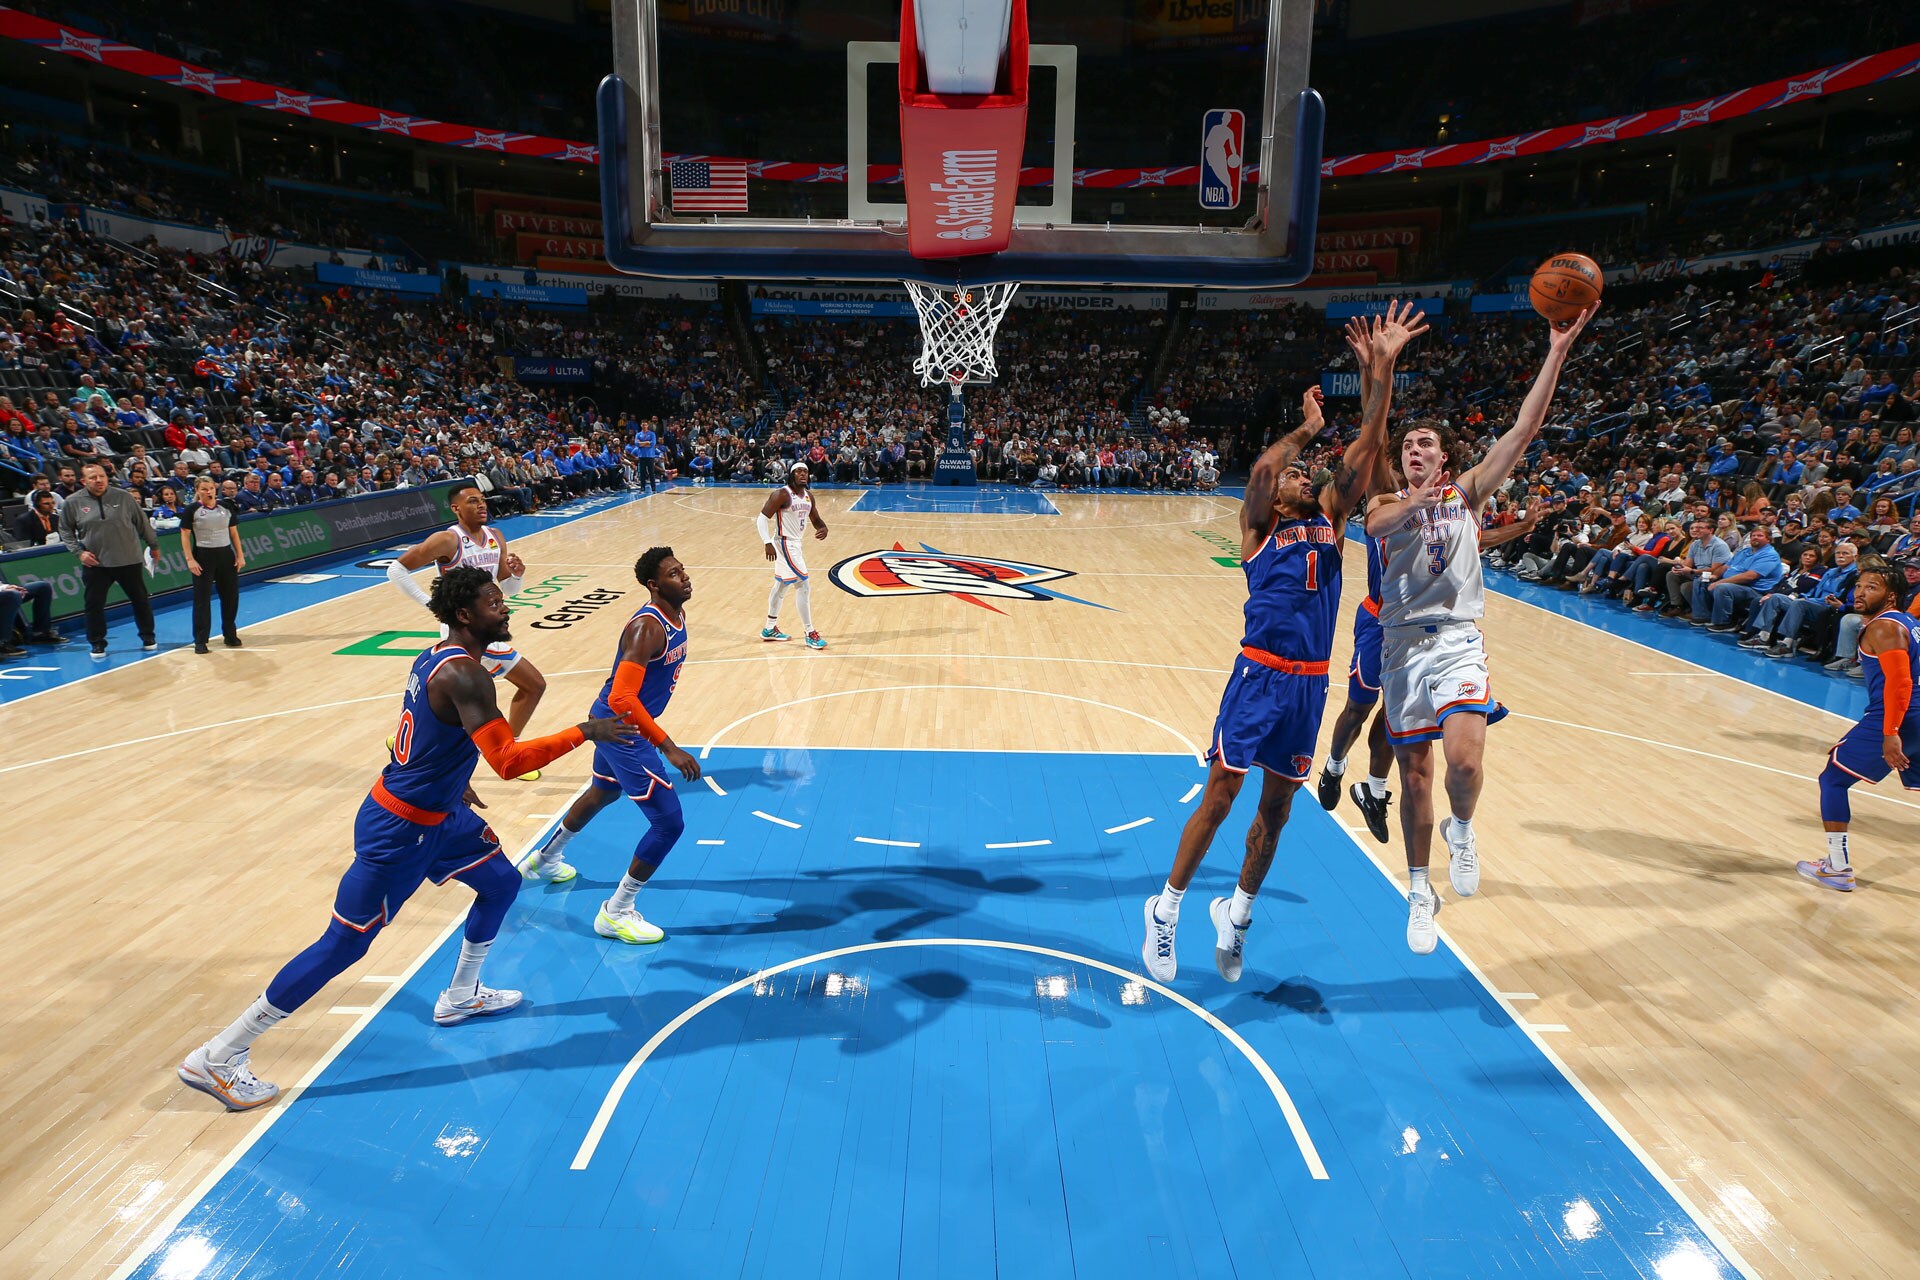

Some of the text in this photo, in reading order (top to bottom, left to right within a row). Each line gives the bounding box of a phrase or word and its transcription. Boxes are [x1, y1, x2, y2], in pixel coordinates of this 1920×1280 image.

[64, 36, 97, 53] SONIC
[184, 72, 212, 86] SONIC
[1790, 80, 1820, 95] SONIC
[279, 96, 307, 108] SONIC
[1682, 109, 1707, 121] SONIC
[382, 118, 407, 129] SONIC
[1588, 127, 1615, 138] SONIC
[477, 135, 502, 145] SONIC
[567, 147, 592, 157] SONIC
[1492, 144, 1516, 154] SONIC
[1396, 156, 1421, 165] SONIC
[821, 170, 843, 178] SONIC
[1142, 174, 1164, 182] SONIC
[1205, 187, 1225, 203] NBA
[502, 214, 595, 237] RIVERW
[1320, 231, 1415, 250] ERWIND
[546, 240, 598, 257] CASI
[1317, 254, 1371, 269] SINO
[1551, 259, 1596, 281] Wilson
[1025, 295, 1114, 308] THUNDER
[1151, 297, 1166, 307] 101
[1200, 297, 1217, 307] 102
[555, 367, 585, 376] ULTRA
[946, 446, 965, 454] Health
[800, 519, 805, 531] 5
[274, 520, 325, 549] Smile
[1275, 526, 1306, 550] NEW
[1422, 522, 1453, 542] CITY
[1427, 542, 1448, 576] 3
[1306, 550, 1318, 591] 1
